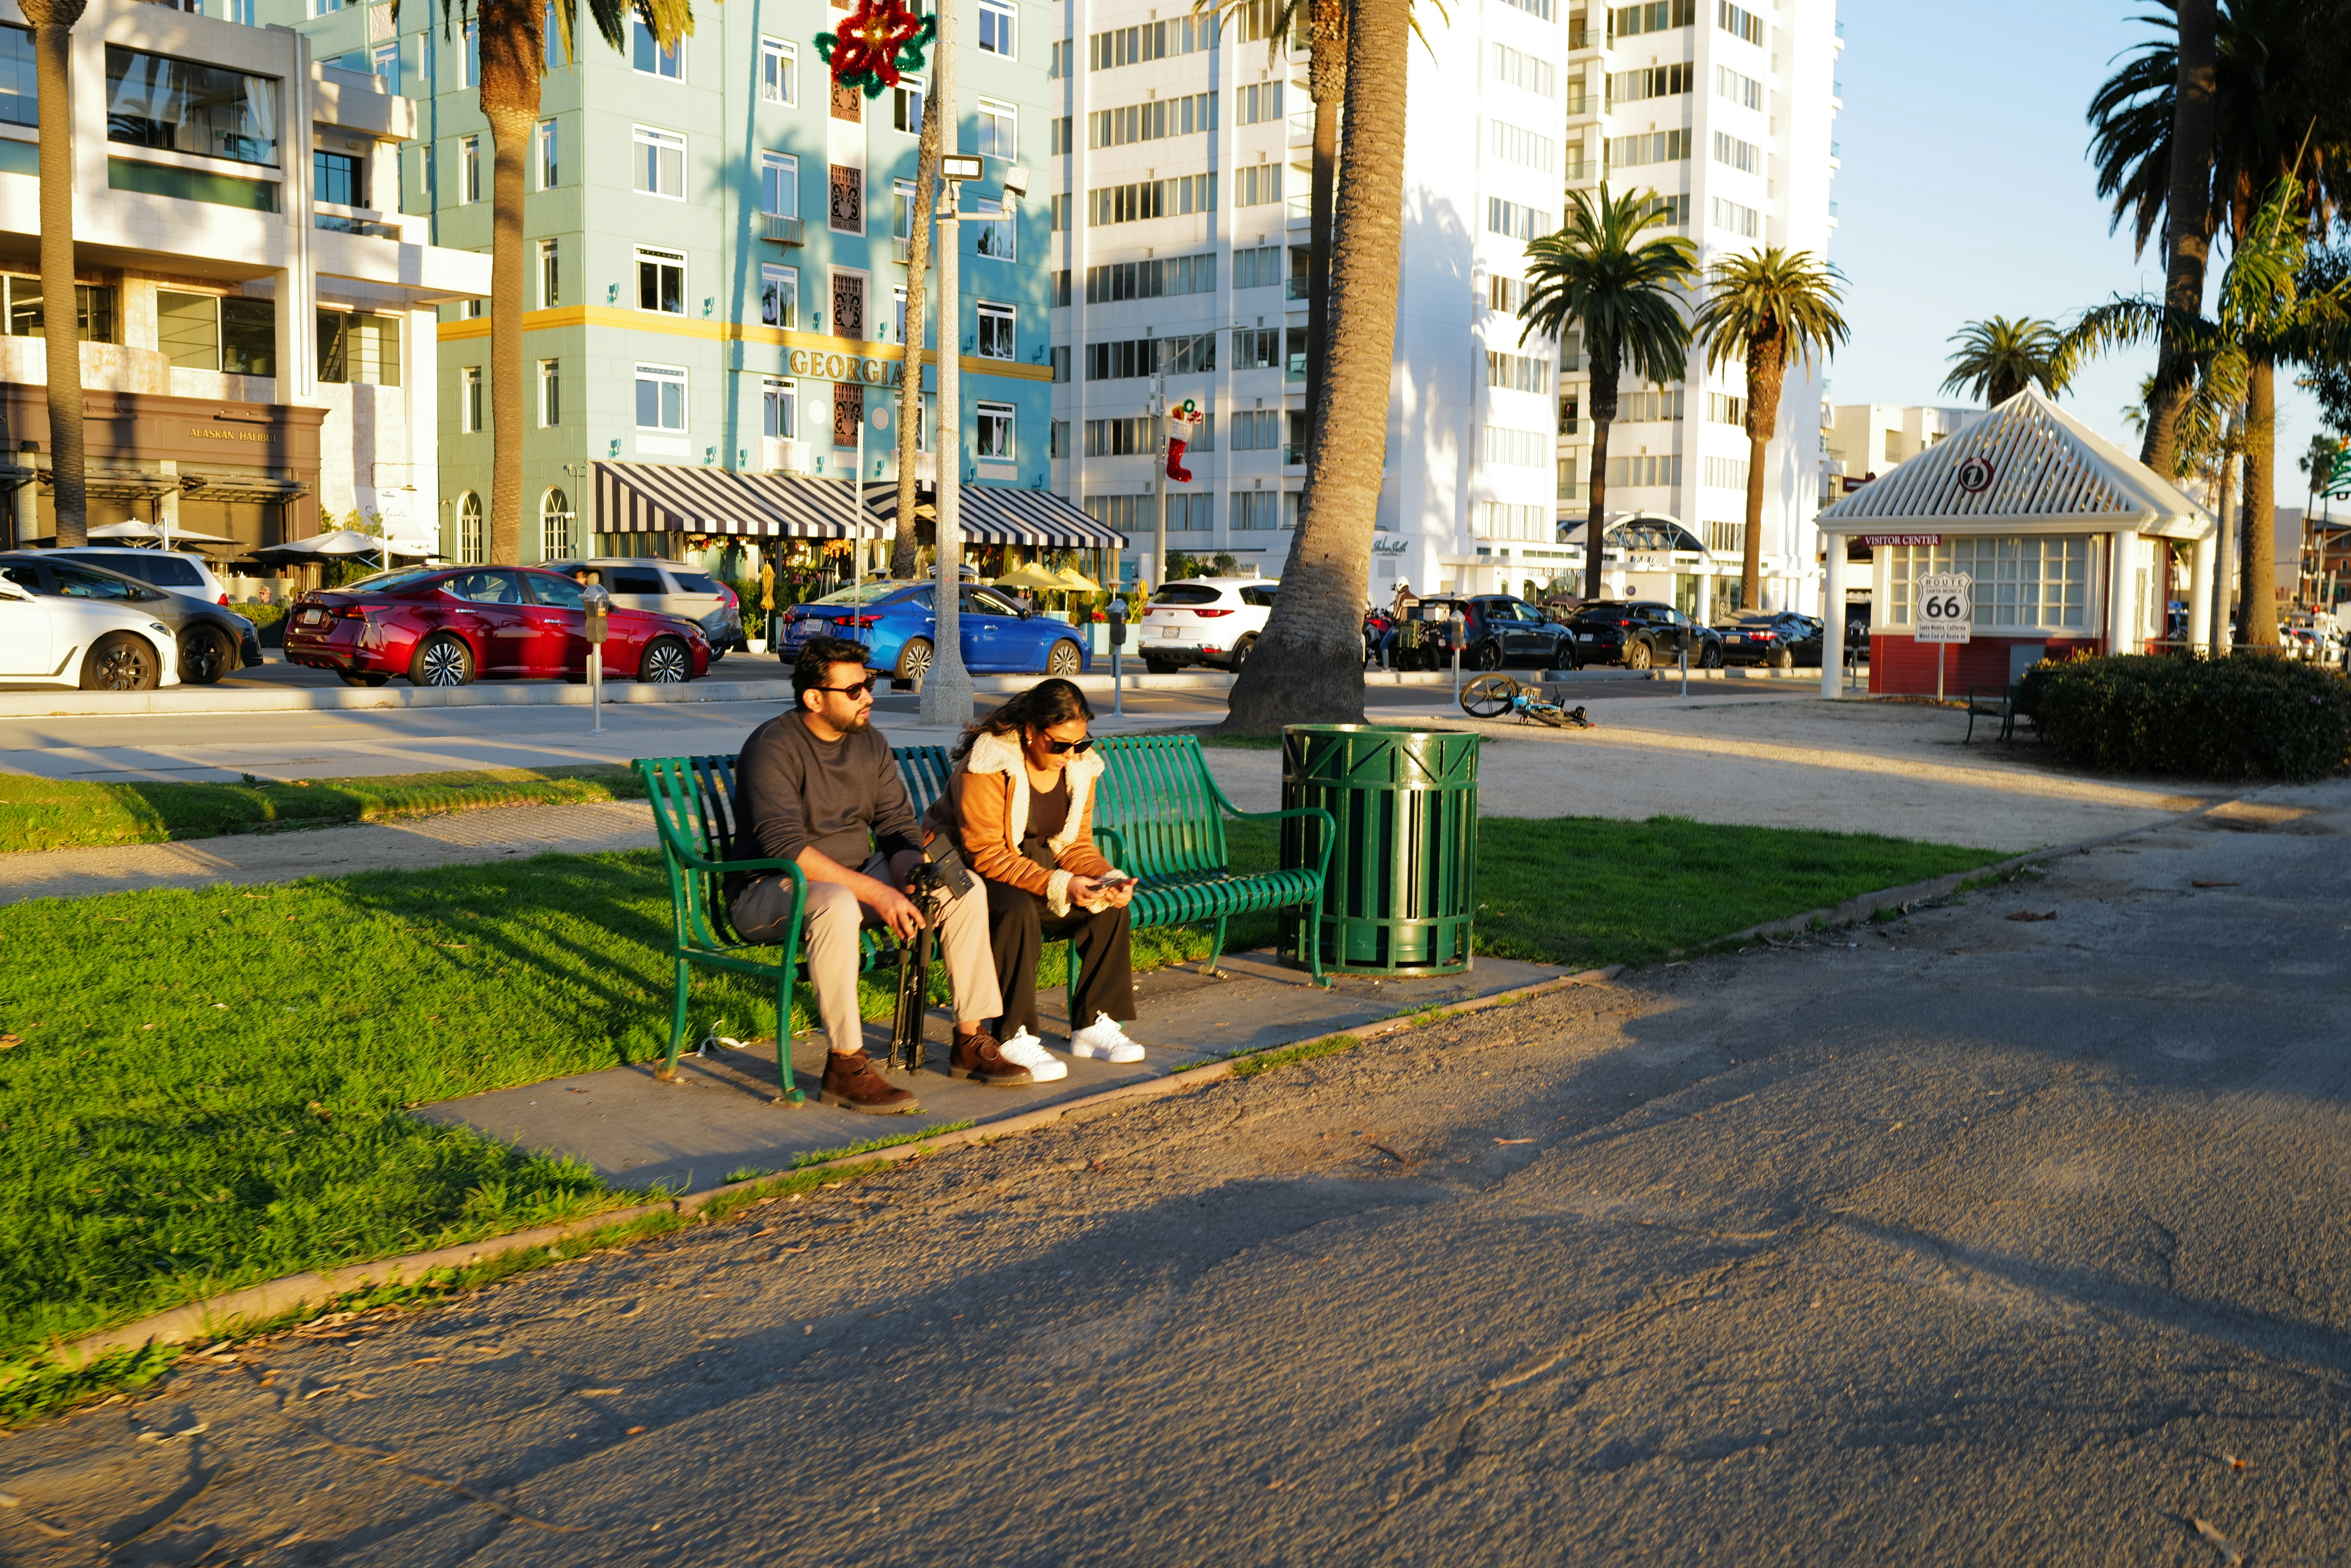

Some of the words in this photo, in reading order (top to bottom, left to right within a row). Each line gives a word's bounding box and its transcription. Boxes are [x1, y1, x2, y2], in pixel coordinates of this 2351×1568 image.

[790, 350, 923, 388] GEORGIA
[189, 428, 234, 440] ALASKAN
[238, 431, 277, 443] HALIBUT
[1865, 535, 1900, 545] VISITOR
[1902, 535, 1938, 545] CENTER
[1544, 567, 1552, 577] GO
[1554, 568, 1571, 577] GREEK
[1574, 569, 1586, 578] YOG
[1926, 596, 1960, 618] 66
